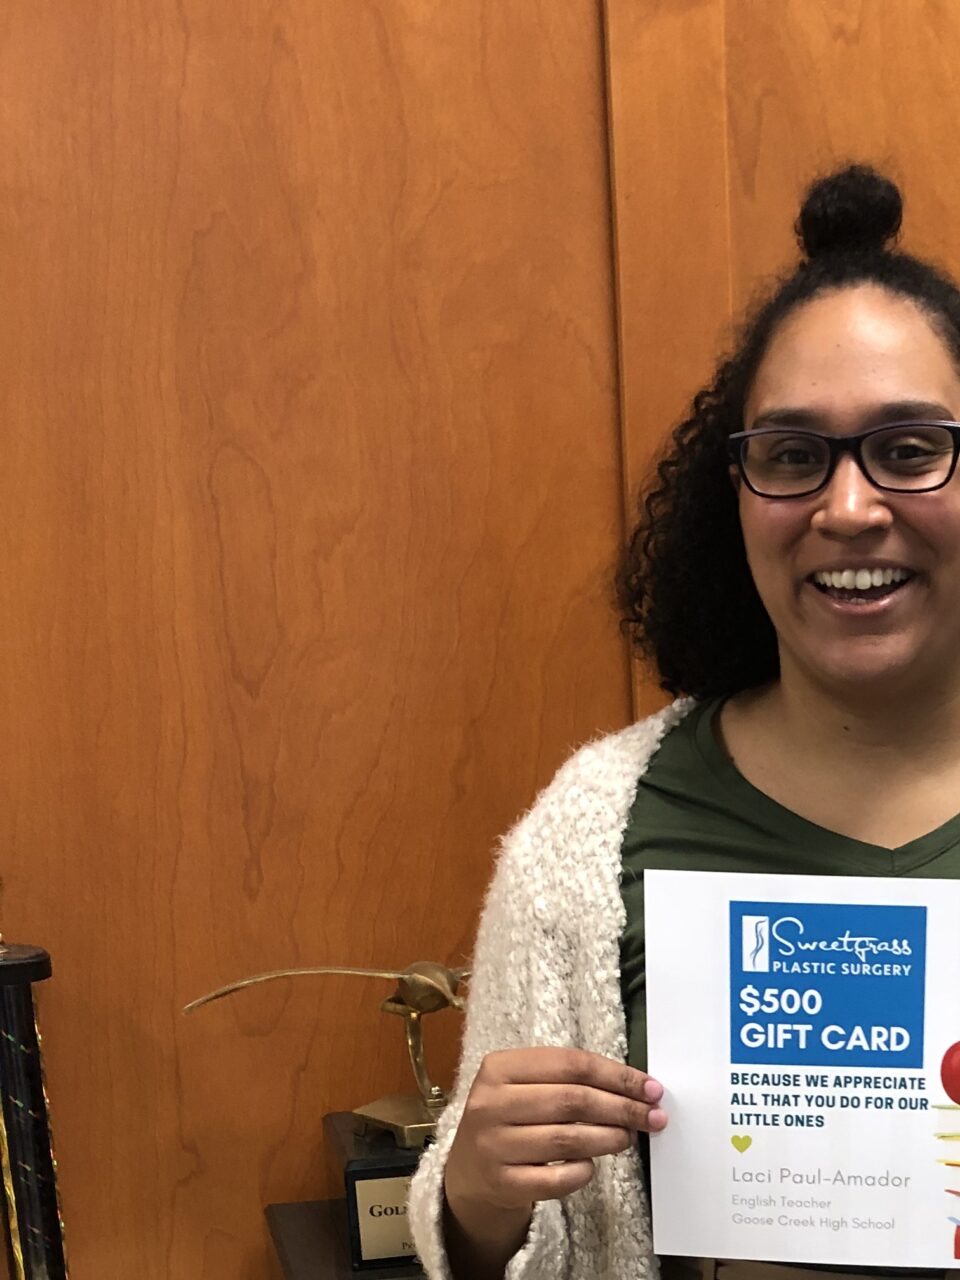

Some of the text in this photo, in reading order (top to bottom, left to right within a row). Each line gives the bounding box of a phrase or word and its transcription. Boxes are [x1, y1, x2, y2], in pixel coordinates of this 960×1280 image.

[772, 917, 912, 962] Sweetgrass
[773, 961, 912, 976] PLASTIC SURGERY
[739, 984, 823, 1016] $500
[740, 1022, 910, 1052] GIFT CARD
[731, 1072, 926, 1090] BECAUSE WE APPRECIATE
[730, 1093, 929, 1111] ALL THAT YOU DO FOR OUR
[731, 1112, 825, 1128] LITTLE ONES
[732, 1166, 911, 1188] Laci Paul-Amador
[731, 1194, 832, 1209] English Teacher
[731, 1213, 895, 1231] Goose Creek High School
